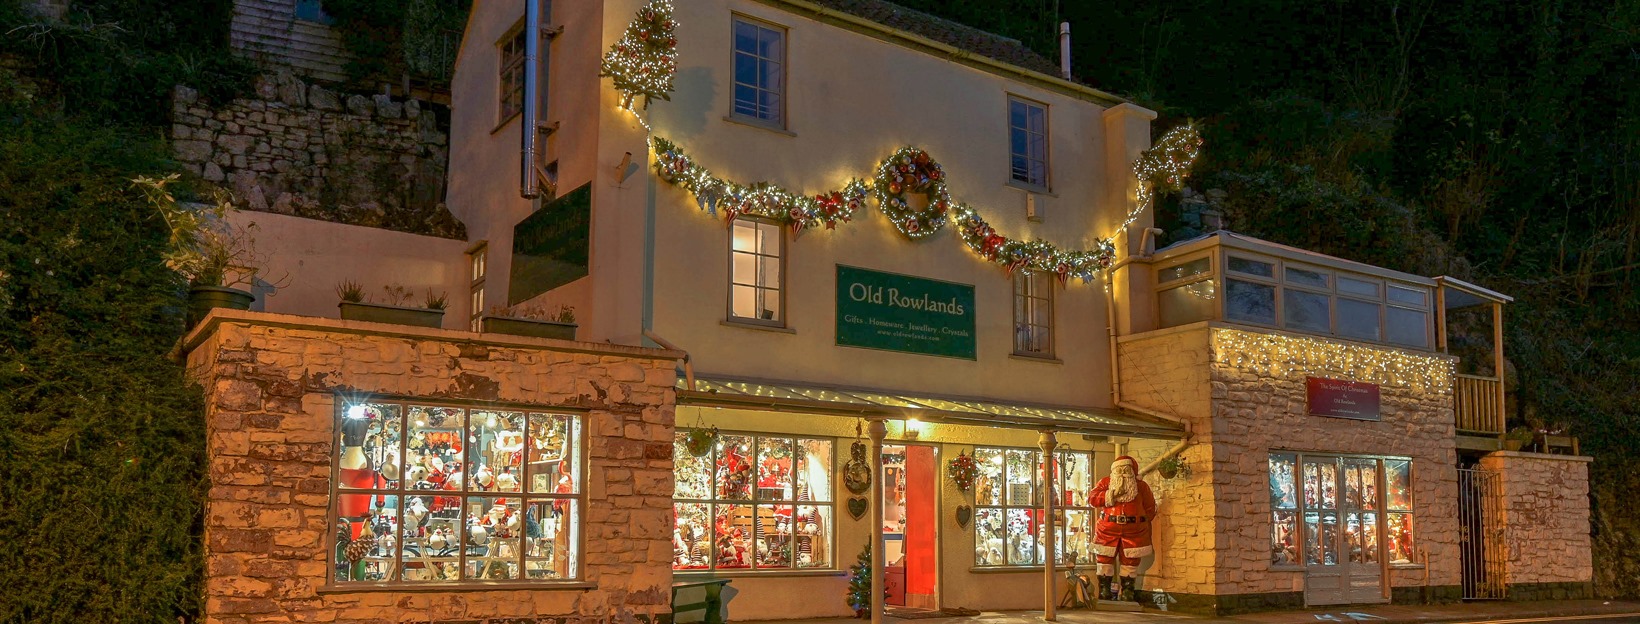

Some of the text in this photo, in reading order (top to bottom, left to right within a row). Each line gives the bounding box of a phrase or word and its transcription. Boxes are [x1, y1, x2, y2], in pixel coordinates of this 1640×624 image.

[849, 283, 964, 316] Old Rowlands
[844, 315, 969, 338] Gifts Homeware Jewellery Crystals
